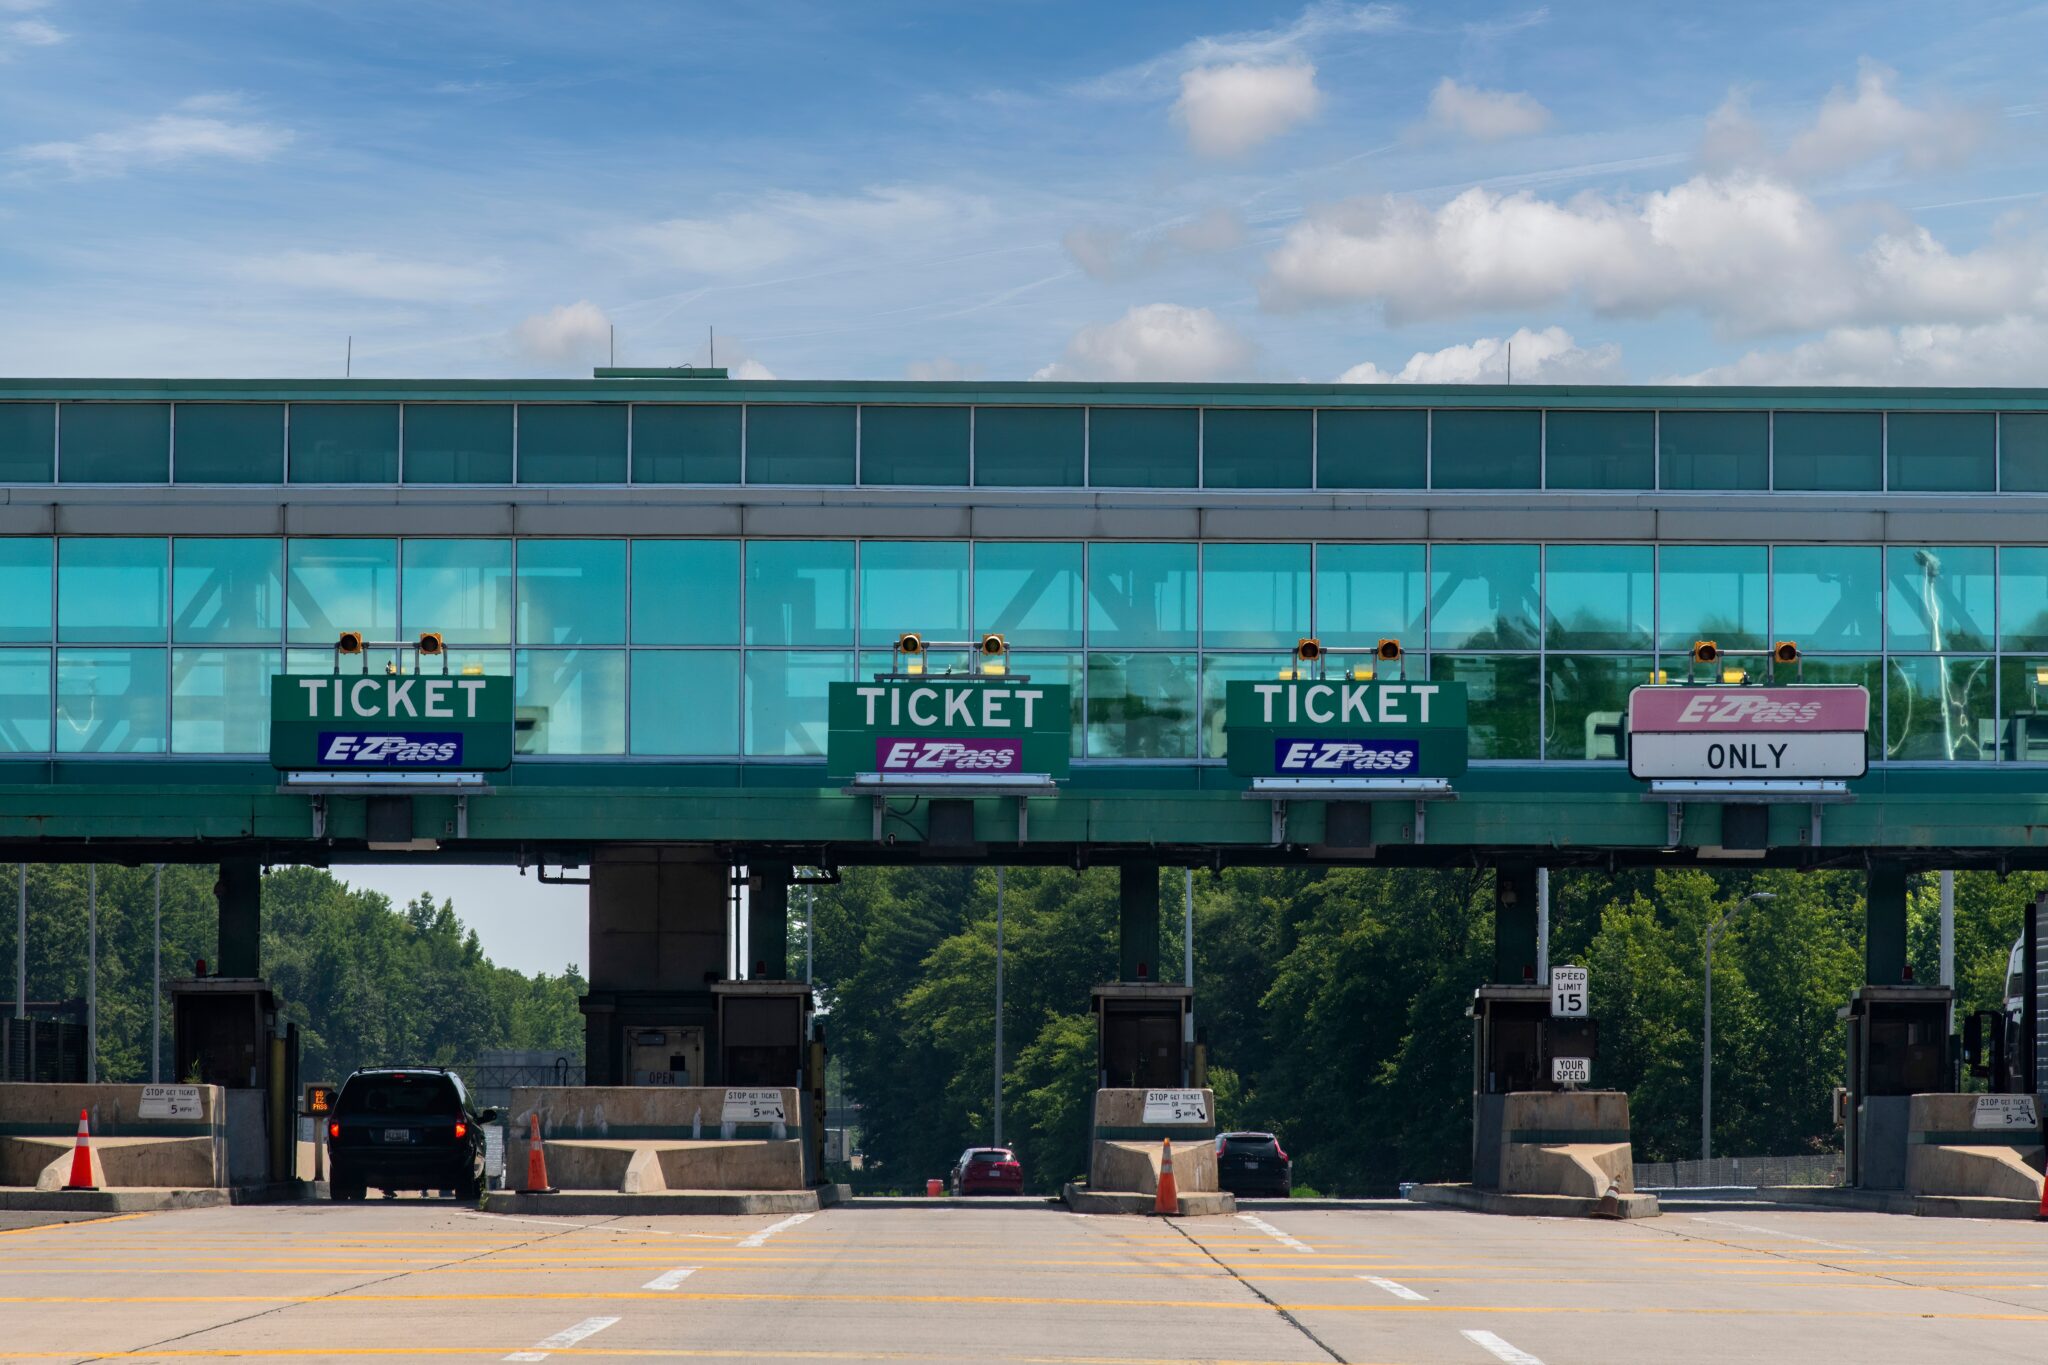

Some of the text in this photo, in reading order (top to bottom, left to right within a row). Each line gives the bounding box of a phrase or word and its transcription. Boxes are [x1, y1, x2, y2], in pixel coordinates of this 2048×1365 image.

[299, 679, 487, 718] TICKET
[1254, 684, 1440, 723] TICKET
[856, 687, 1044, 728] TICKET
[1707, 743, 1789, 769] ONLY
[1555, 972, 1586, 981] SPEED
[1557, 983, 1582, 991] LIMIT
[1558, 993, 1582, 1012] 15
[1560, 1060, 1584, 1070] YOUR
[650, 1072, 675, 1085] OPEN
[1556, 1072, 1586, 1080] SPEED
[172, 1104, 178, 1114] 5
[754, 1108, 760, 1118] 5
[1176, 1110, 1182, 1119] 5
[2006, 1114, 2013, 1124] 5
